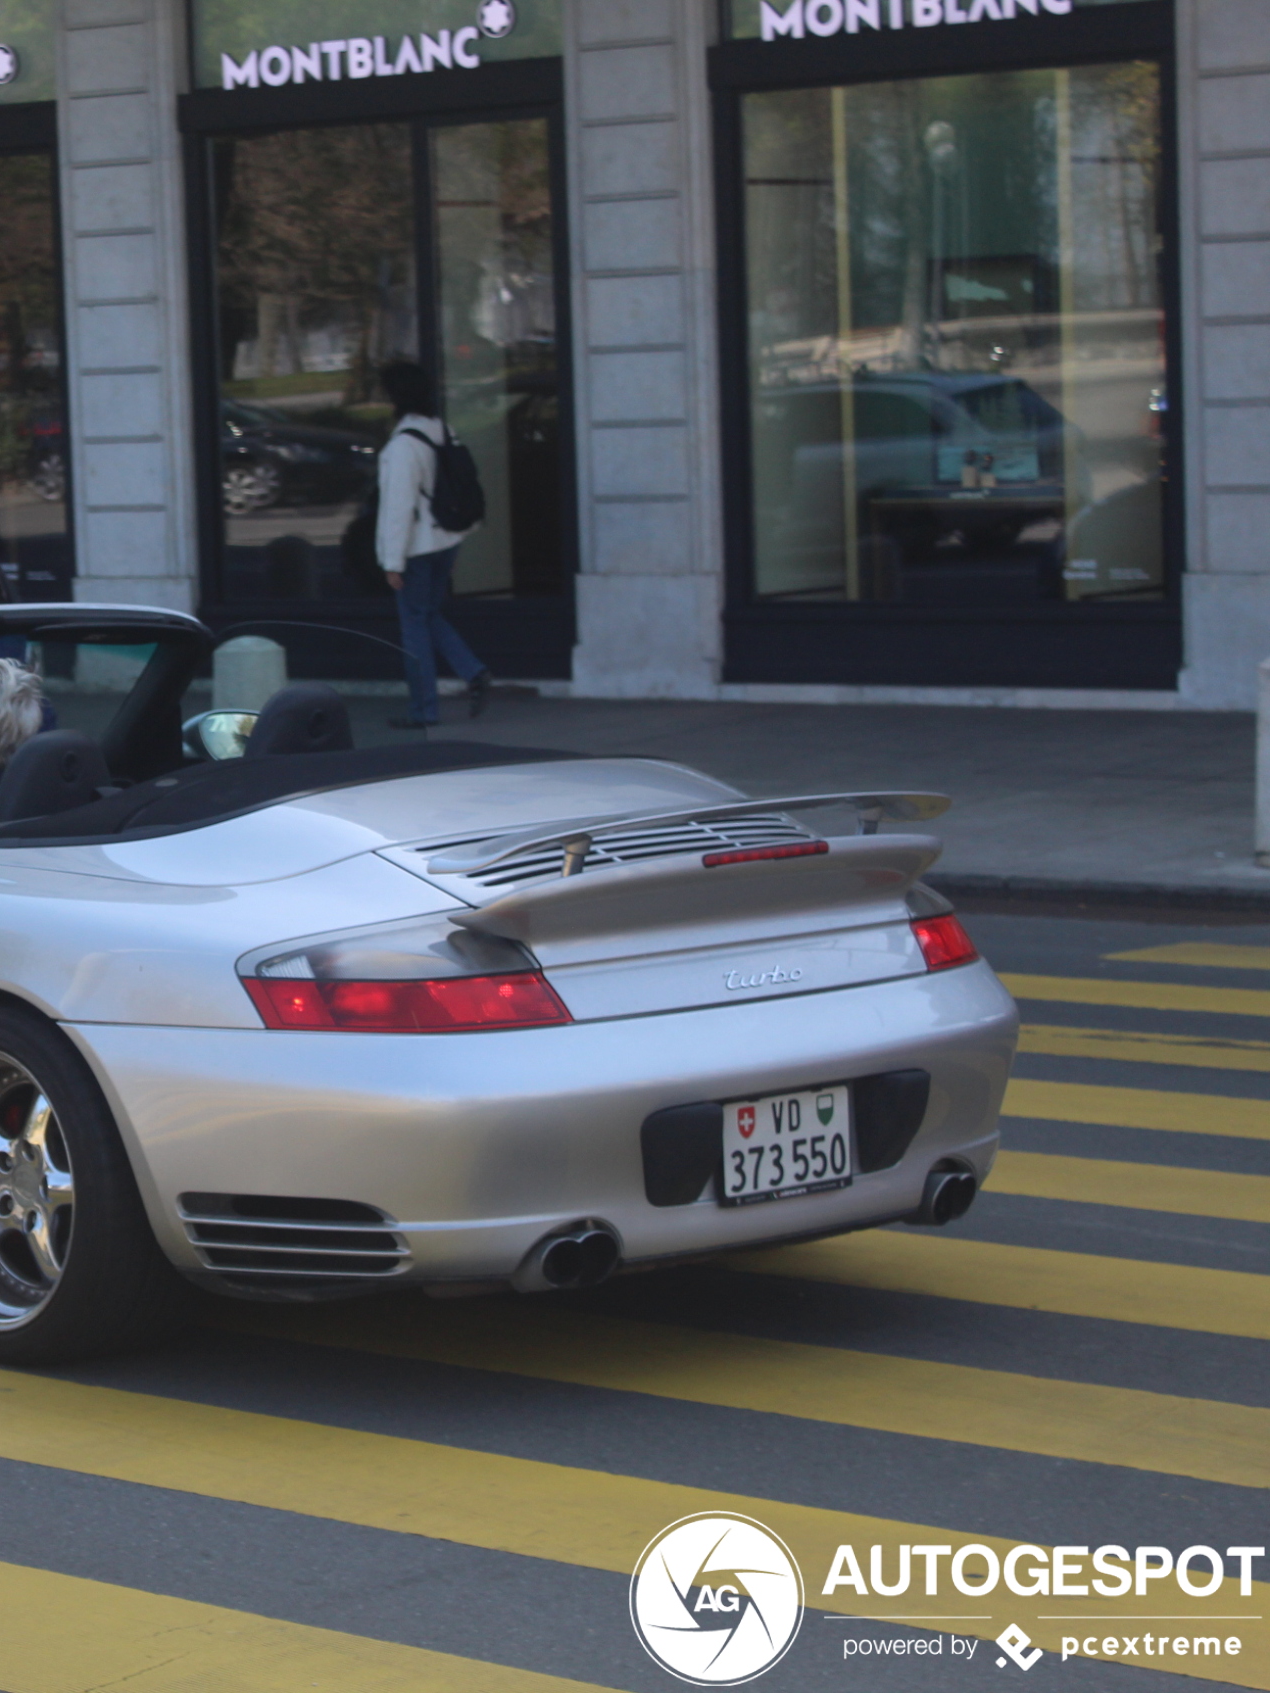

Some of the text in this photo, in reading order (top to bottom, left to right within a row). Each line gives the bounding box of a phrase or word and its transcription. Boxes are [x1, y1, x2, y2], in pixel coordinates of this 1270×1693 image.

[221, 26, 480, 90] MONTBLANC
[723, 965, 803, 990] turbo
[772, 1099, 801, 1134] VD
[731, 1133, 846, 1192] 373 550
